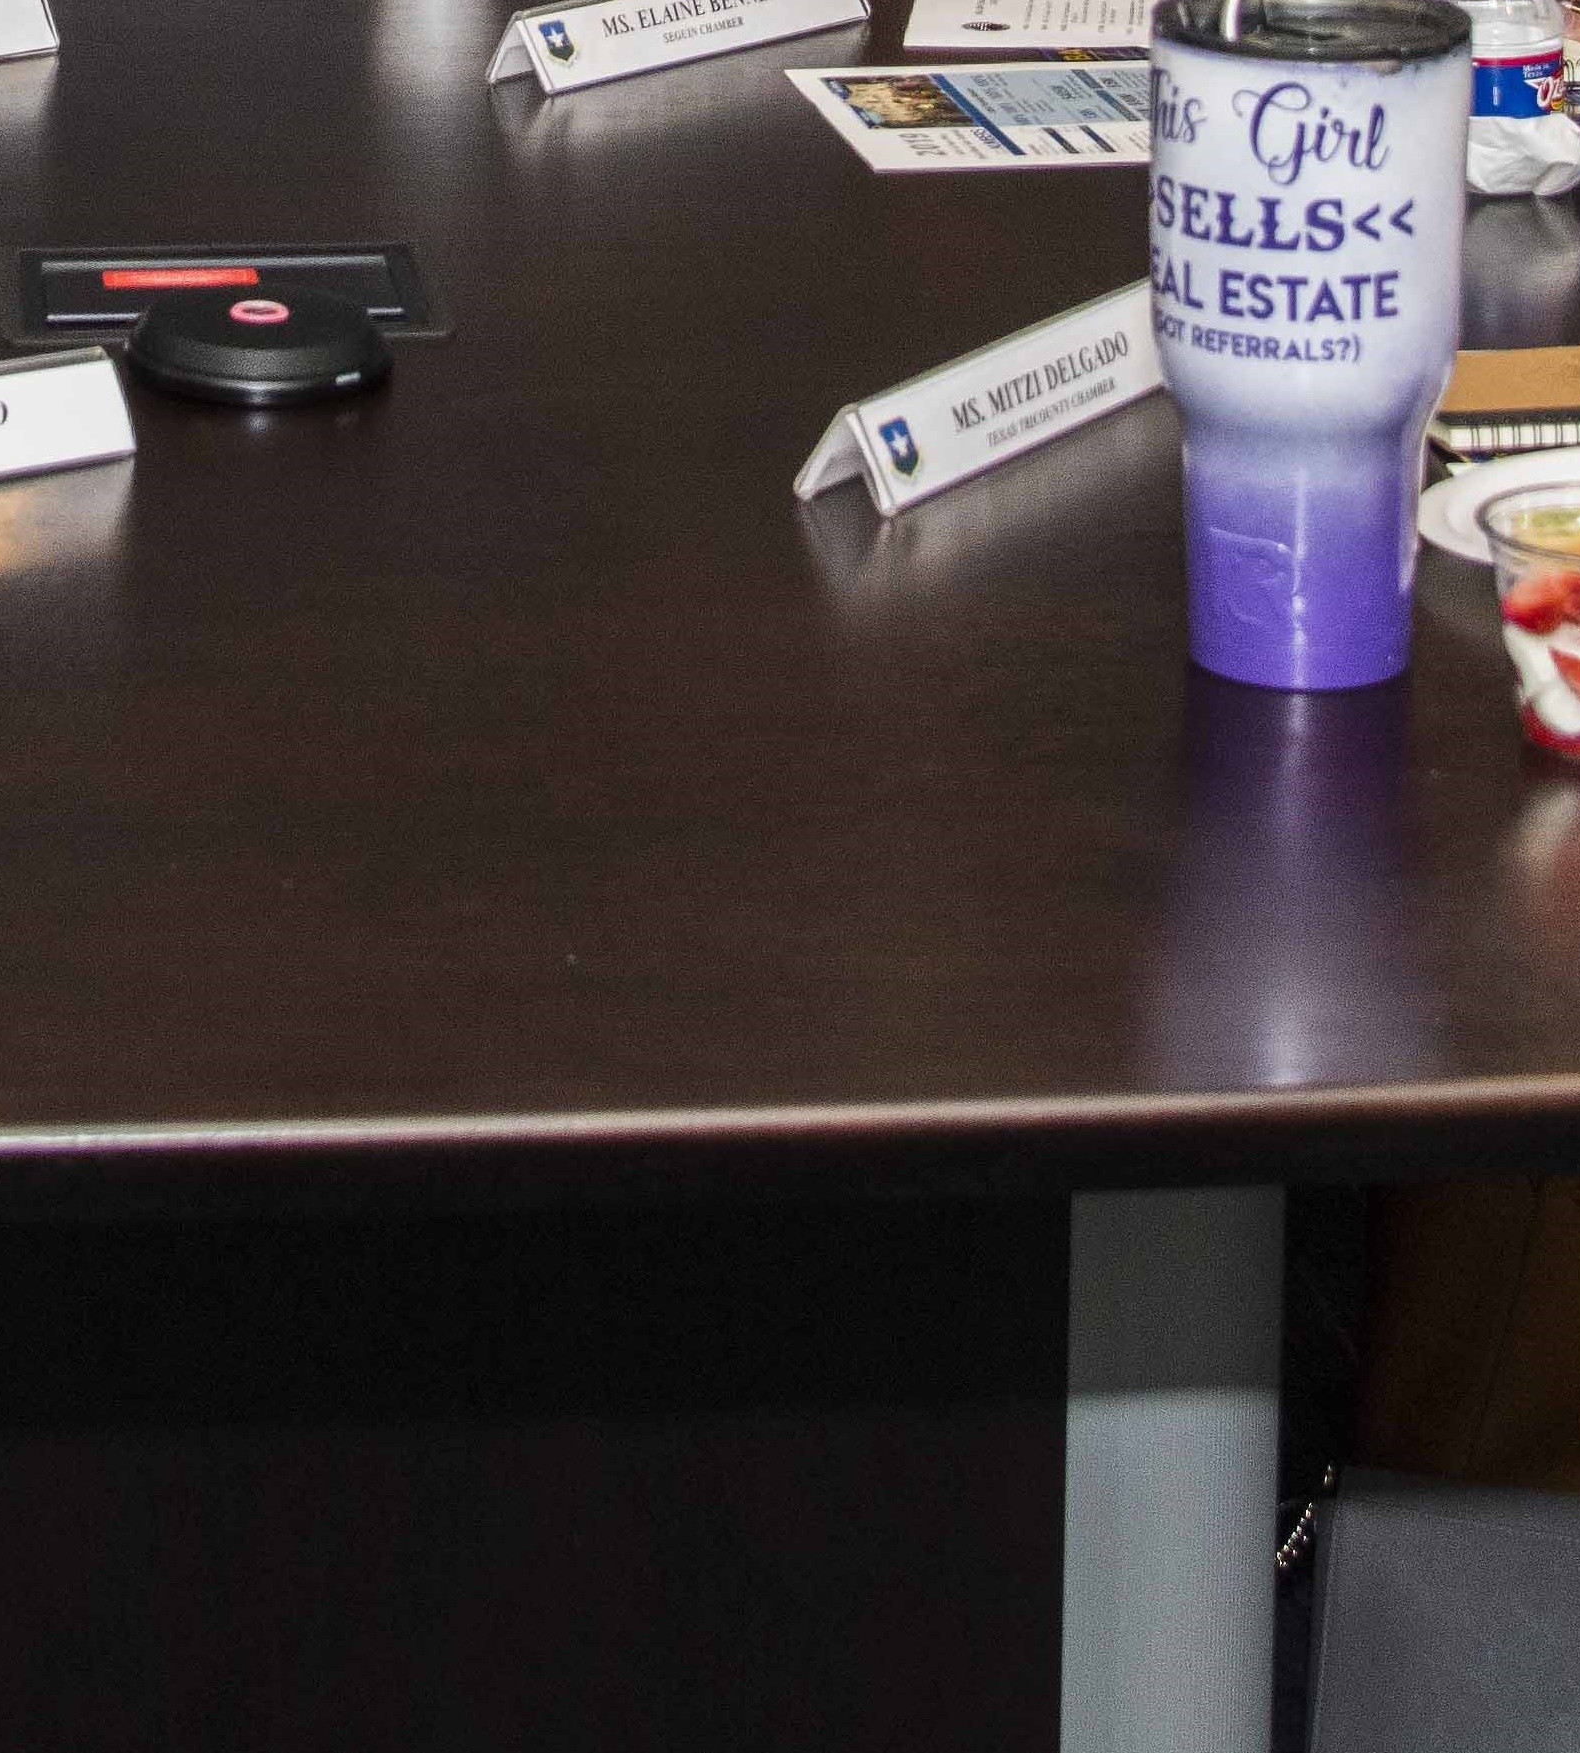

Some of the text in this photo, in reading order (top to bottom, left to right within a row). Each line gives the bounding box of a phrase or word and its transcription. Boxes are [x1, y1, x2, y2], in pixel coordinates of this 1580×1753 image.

[602, 14, 634, 39] MS.
[663, 17, 744, 44] SEGUIN CHAMBER
[1231, 81, 1391, 185] Girl
[1219, 268, 1401, 322] ESTATE
[951, 331, 1129, 430] MS. MITZI DELGADO
